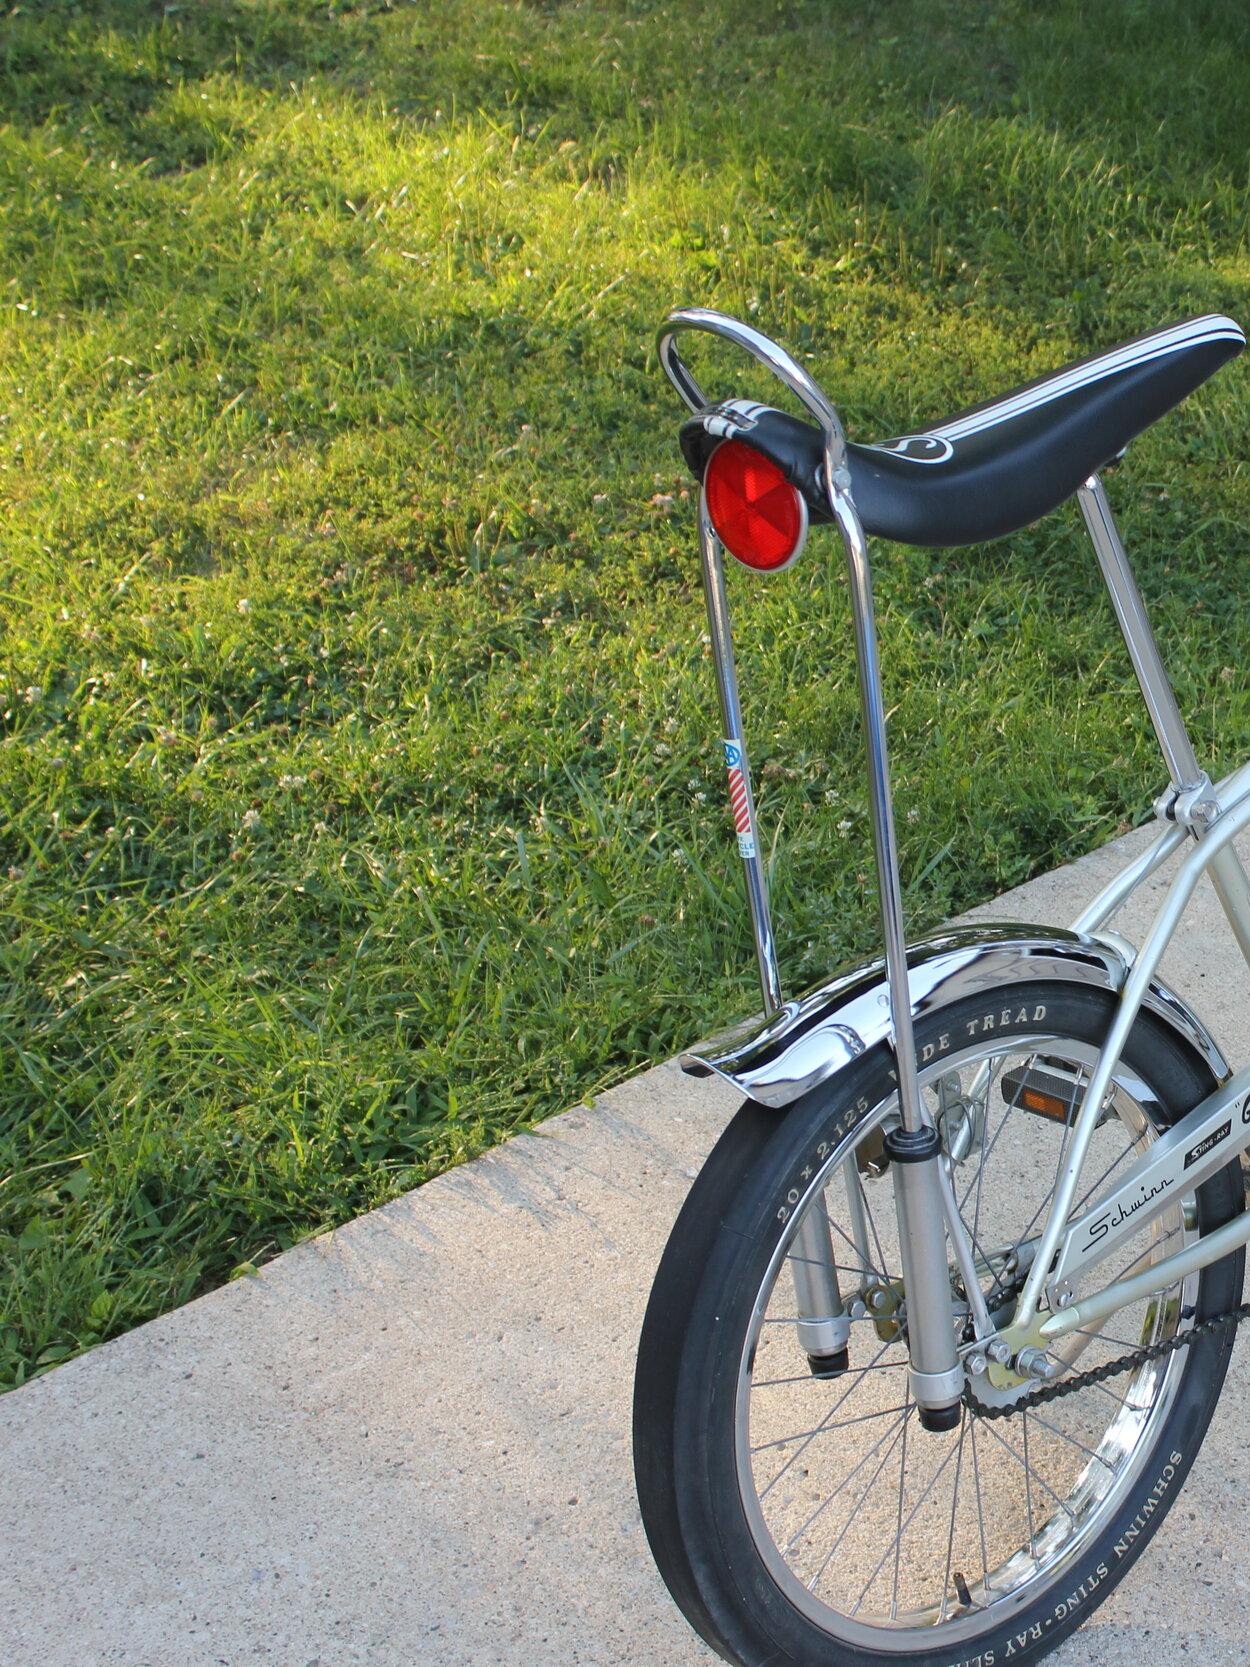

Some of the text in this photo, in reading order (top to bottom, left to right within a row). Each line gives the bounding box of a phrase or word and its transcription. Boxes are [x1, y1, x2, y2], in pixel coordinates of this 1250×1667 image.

[777, 1188, 799, 1224] 20
[816, 1096, 869, 1160] 2.125
[966, 1005, 1048, 1036] TREAD
[1082, 1179, 1174, 1252] Schwinn
[1191, 1126, 1229, 1159] STING-RAY
[1113, 1450, 1182, 1558] SCHWINN
